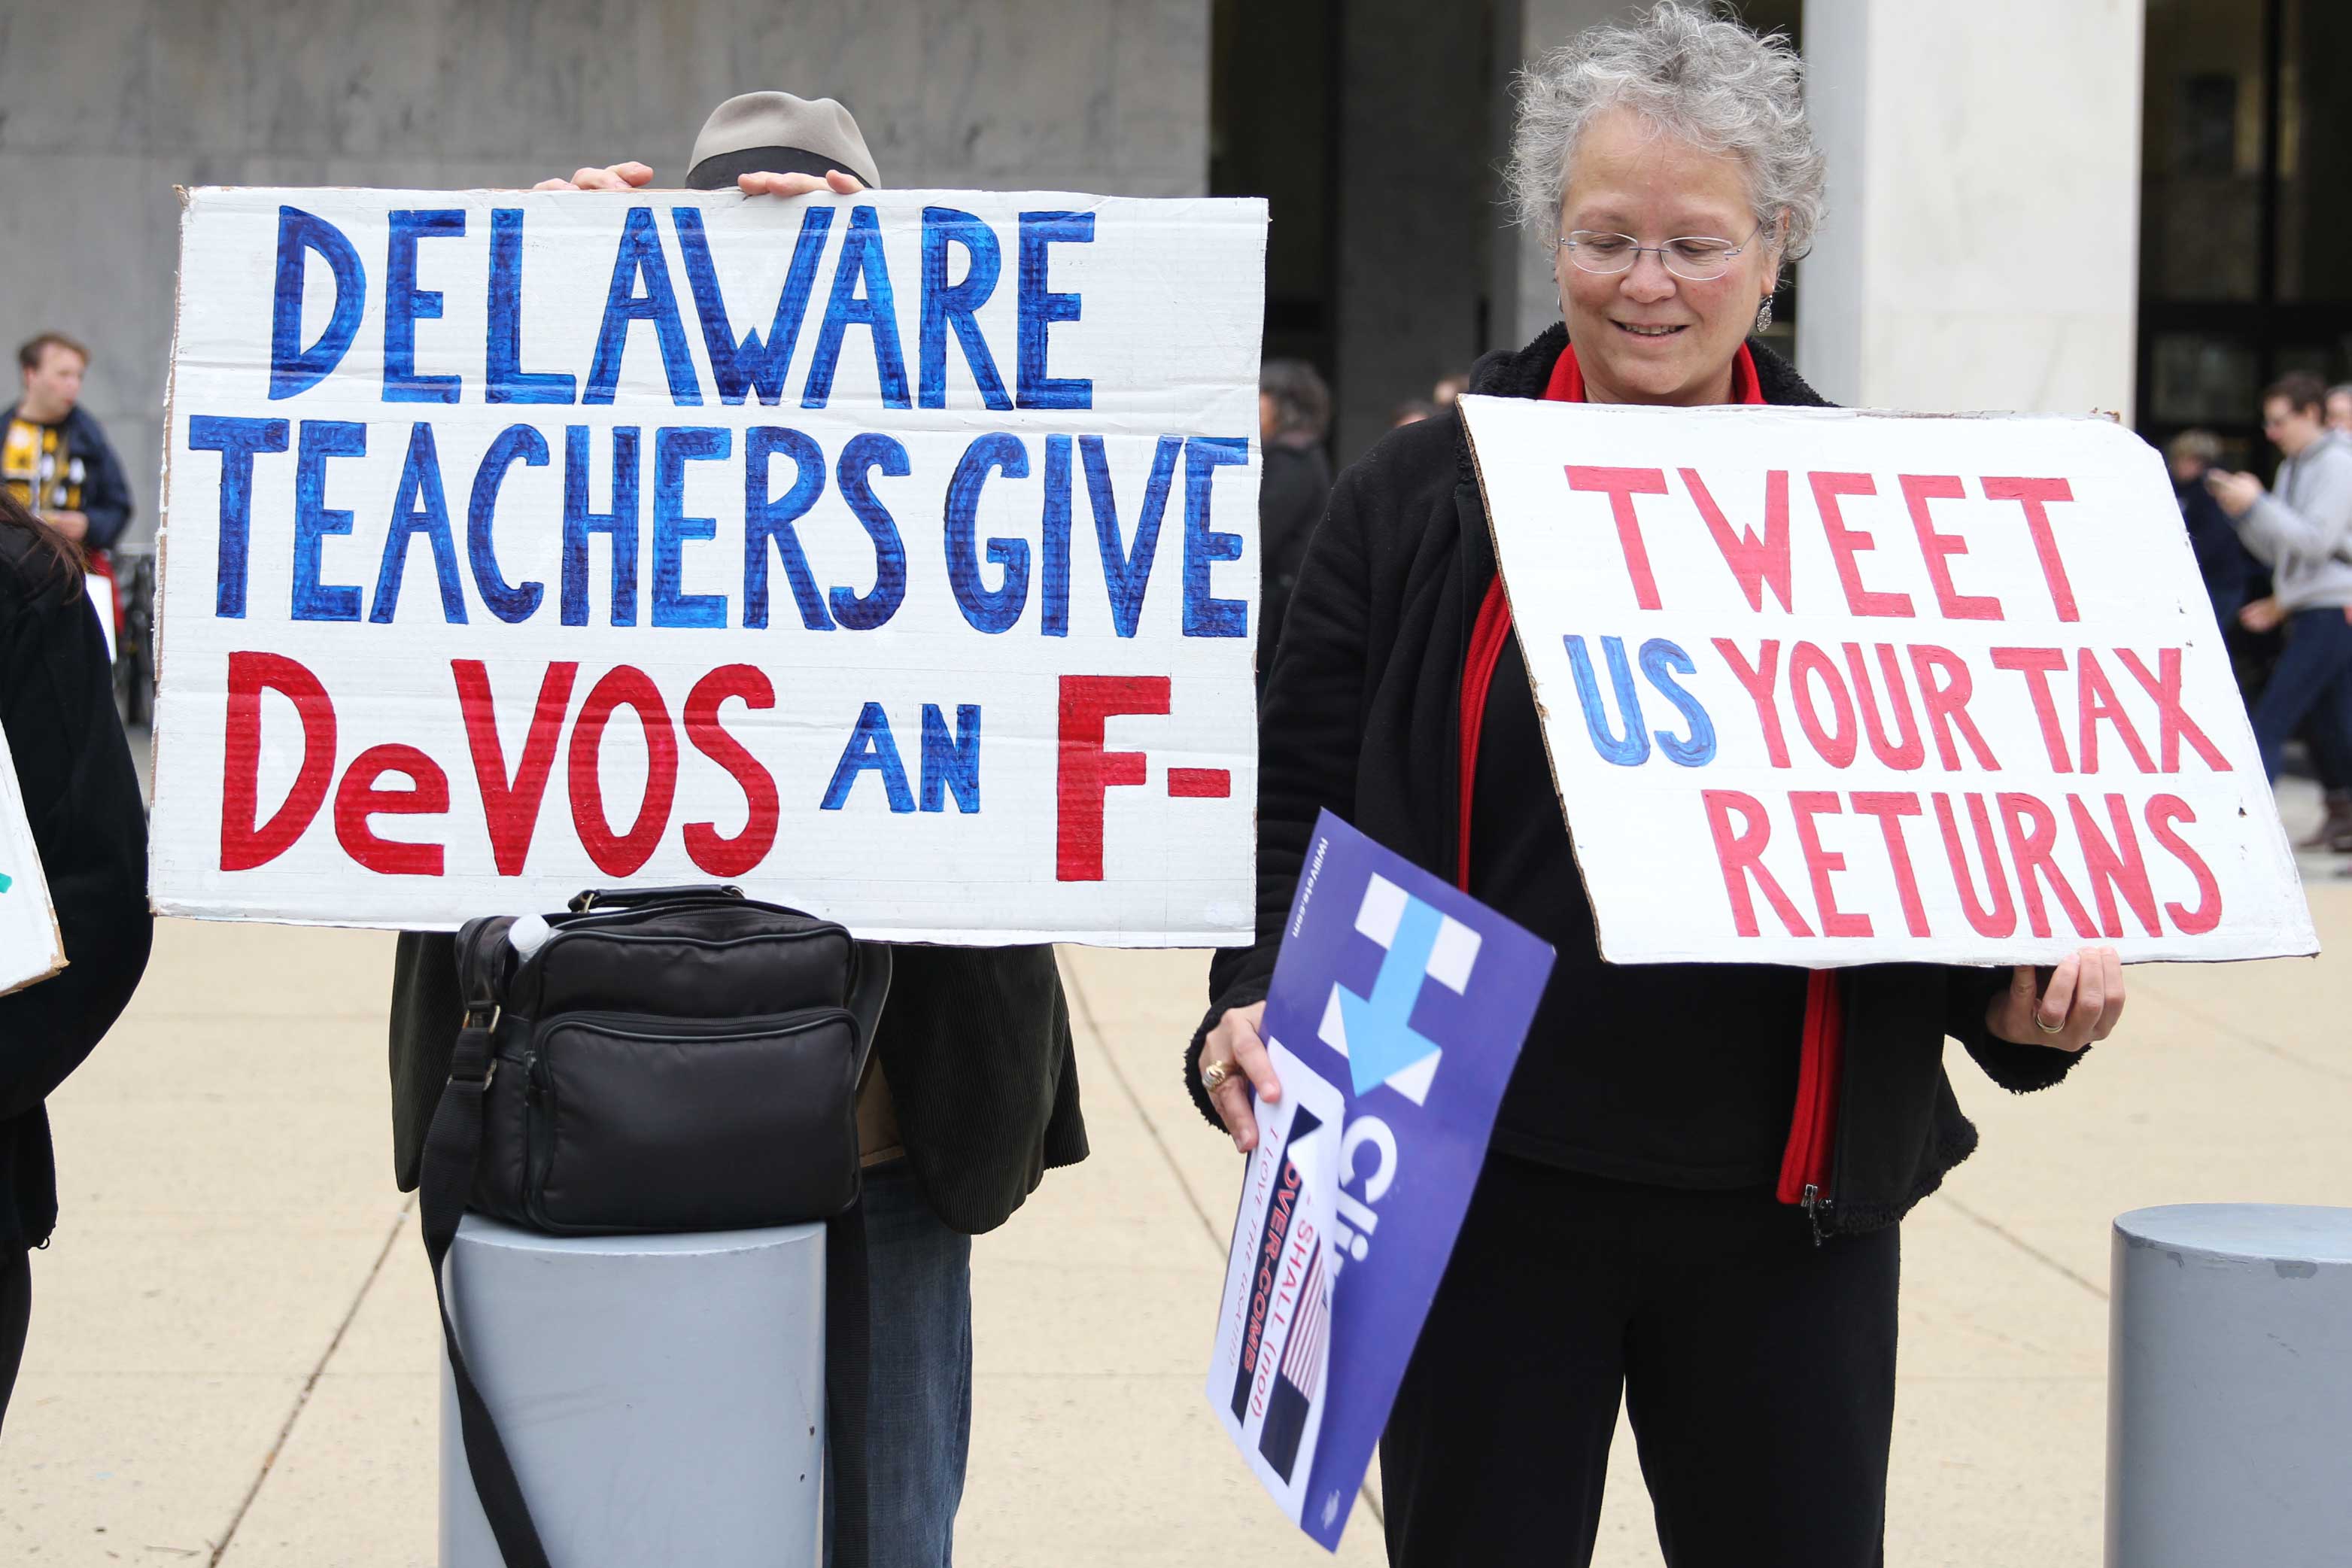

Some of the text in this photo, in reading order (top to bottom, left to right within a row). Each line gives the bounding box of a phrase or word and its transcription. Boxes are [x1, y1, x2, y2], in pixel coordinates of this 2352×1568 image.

[268, 205, 1095, 411] DELAWARE
[189, 415, 1249, 638] TEACHERS GIVE
[1563, 464, 2080, 623] TWEET
[220, 650, 1231, 883] DeVOS AN F-
[1563, 634, 2233, 775] US YOUR TAX
[1700, 789, 2223, 939] RETURNS
[1254, 1145, 1275, 1208] LOVE
[1334, 1114, 1397, 1278] Cli
[1250, 1218, 1314, 1418] SHALL (not)
